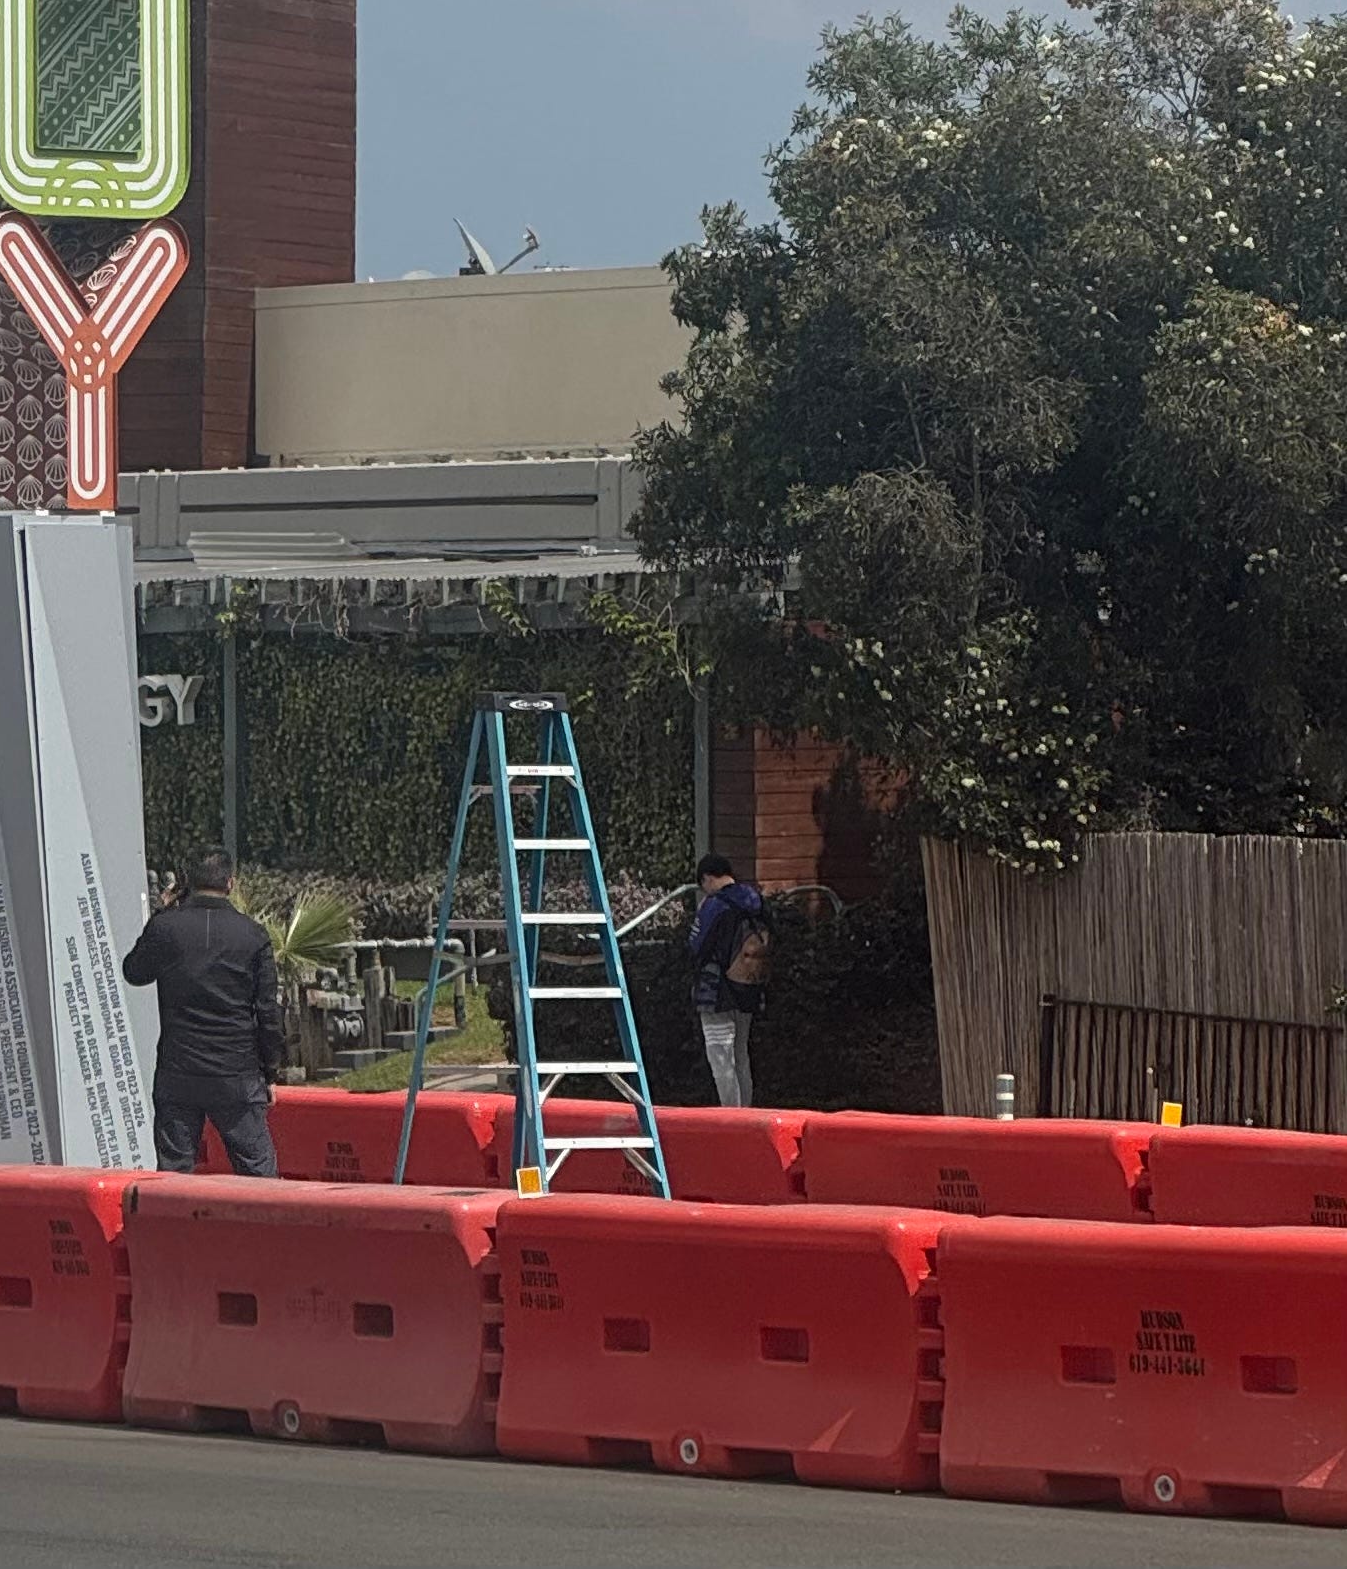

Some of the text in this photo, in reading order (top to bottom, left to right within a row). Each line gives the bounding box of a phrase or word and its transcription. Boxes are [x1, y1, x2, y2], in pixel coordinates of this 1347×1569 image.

[80, 853, 94, 885] ASIAN
[88, 887, 107, 939] BUSINESS
[65, 936, 80, 962] SIGN
[71, 964, 90, 1011] CONCEPT
[99, 942, 121, 1009] ASSOCIATION
[82, 1014, 95, 1036] AND
[113, 1012, 127, 1032] SAN
[4, 970, 25, 1039] ASSOCIATION
[15, 1041, 36, 1108] FOUNDATION
[63, 981, 81, 1027] PROJECT
[86, 1086, 99, 1112] MCM
[119, 1036, 134, 1067] DIEGO
[0, 1029, 18, 1084] PRESIDENT
[109, 1044, 124, 1079] BOARD
[8, 1088, 20, 1096] &
[116, 1080, 128, 1093] OF
[10, 1099, 24, 1119] CEO
[119, 1095, 139, 1152] DIRECTORS
[131, 1154, 142, 1164] &
